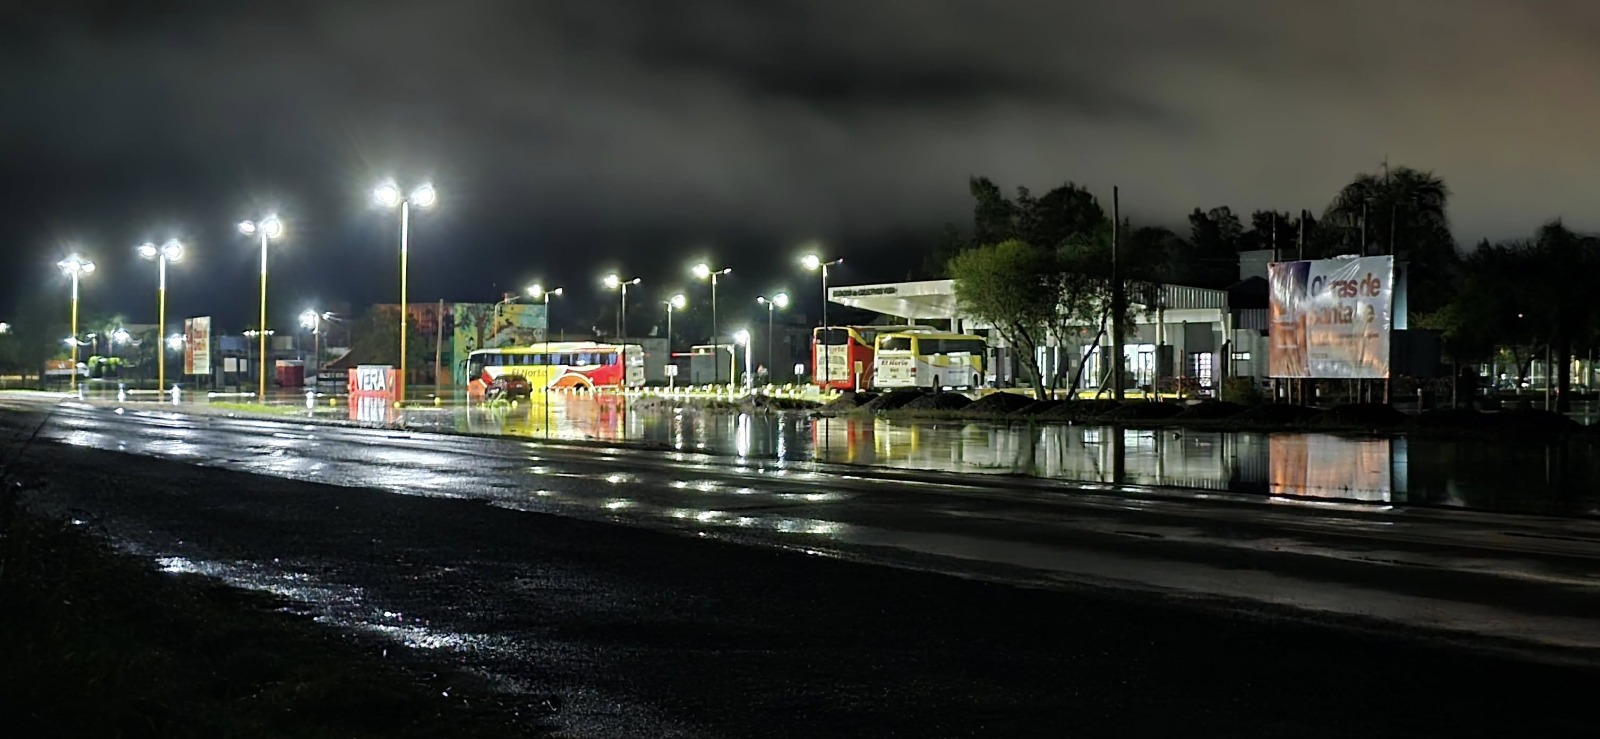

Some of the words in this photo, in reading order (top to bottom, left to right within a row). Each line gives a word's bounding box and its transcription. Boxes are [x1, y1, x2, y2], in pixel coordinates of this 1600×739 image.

[1311, 275, 1358, 298] Oras
[1360, 272, 1381, 297] de
[357, 367, 387, 391] VERA
